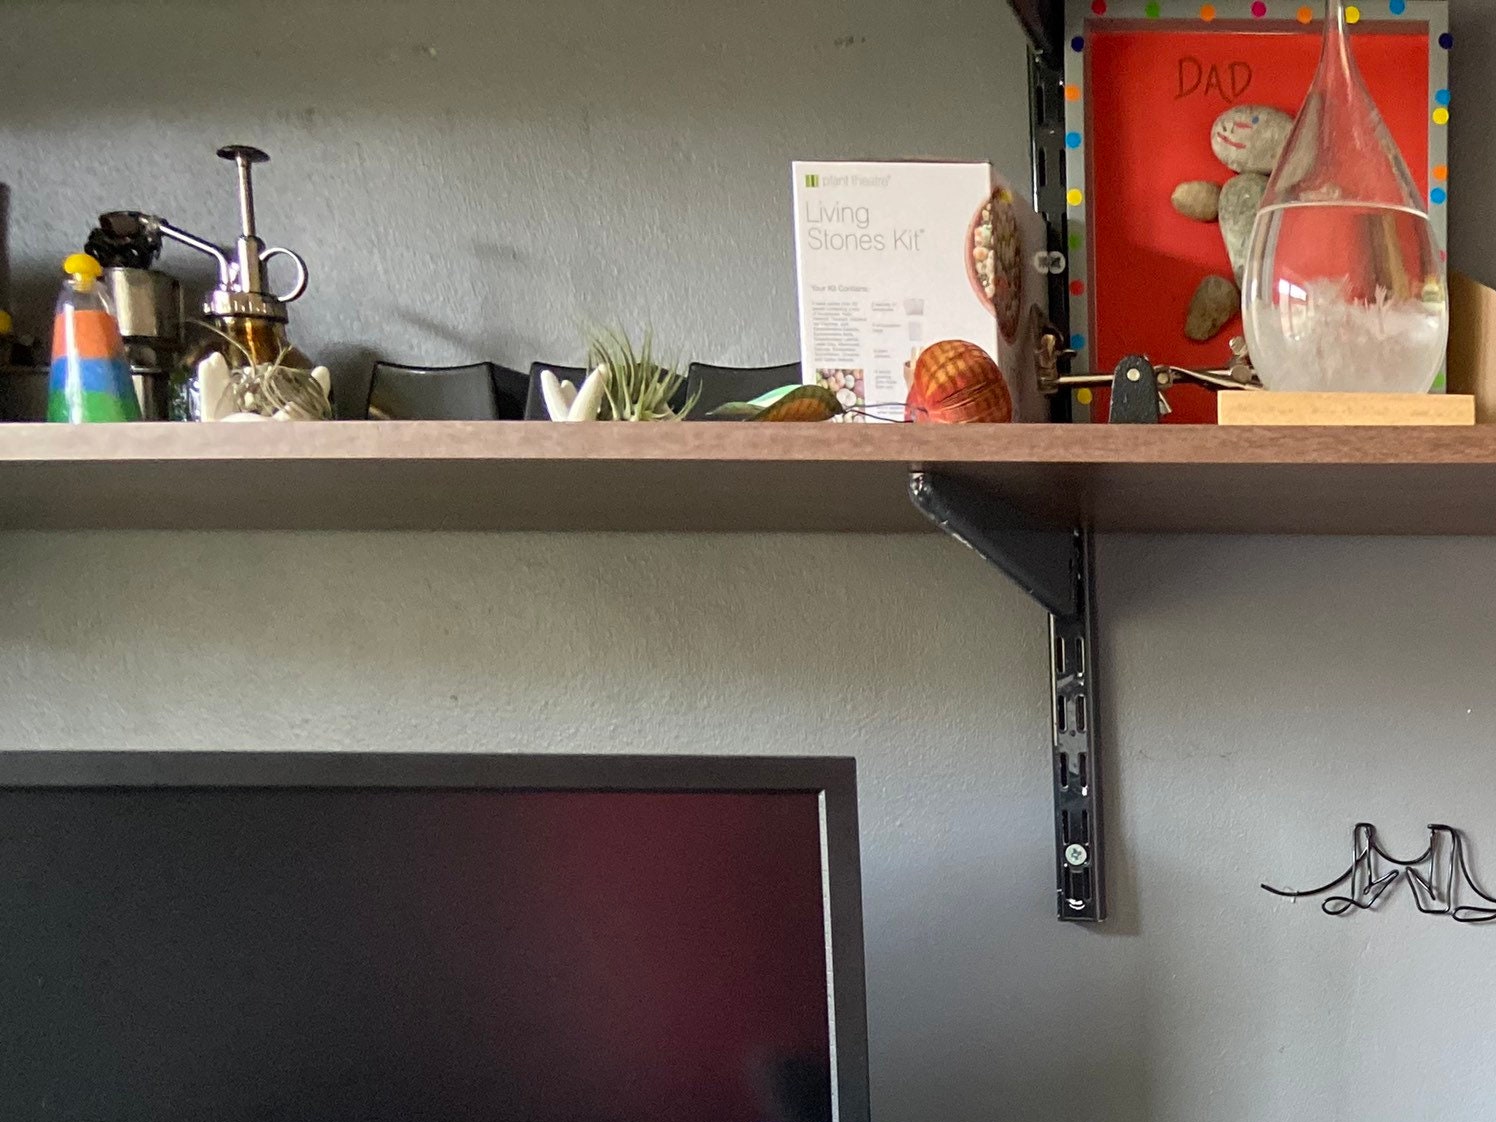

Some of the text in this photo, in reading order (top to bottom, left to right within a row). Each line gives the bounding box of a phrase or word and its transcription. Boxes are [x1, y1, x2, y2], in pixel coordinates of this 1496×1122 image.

[1174, 55, 1252, 103] DAD
[806, 201, 870, 229] Living
[808, 228, 886, 251] Stones
